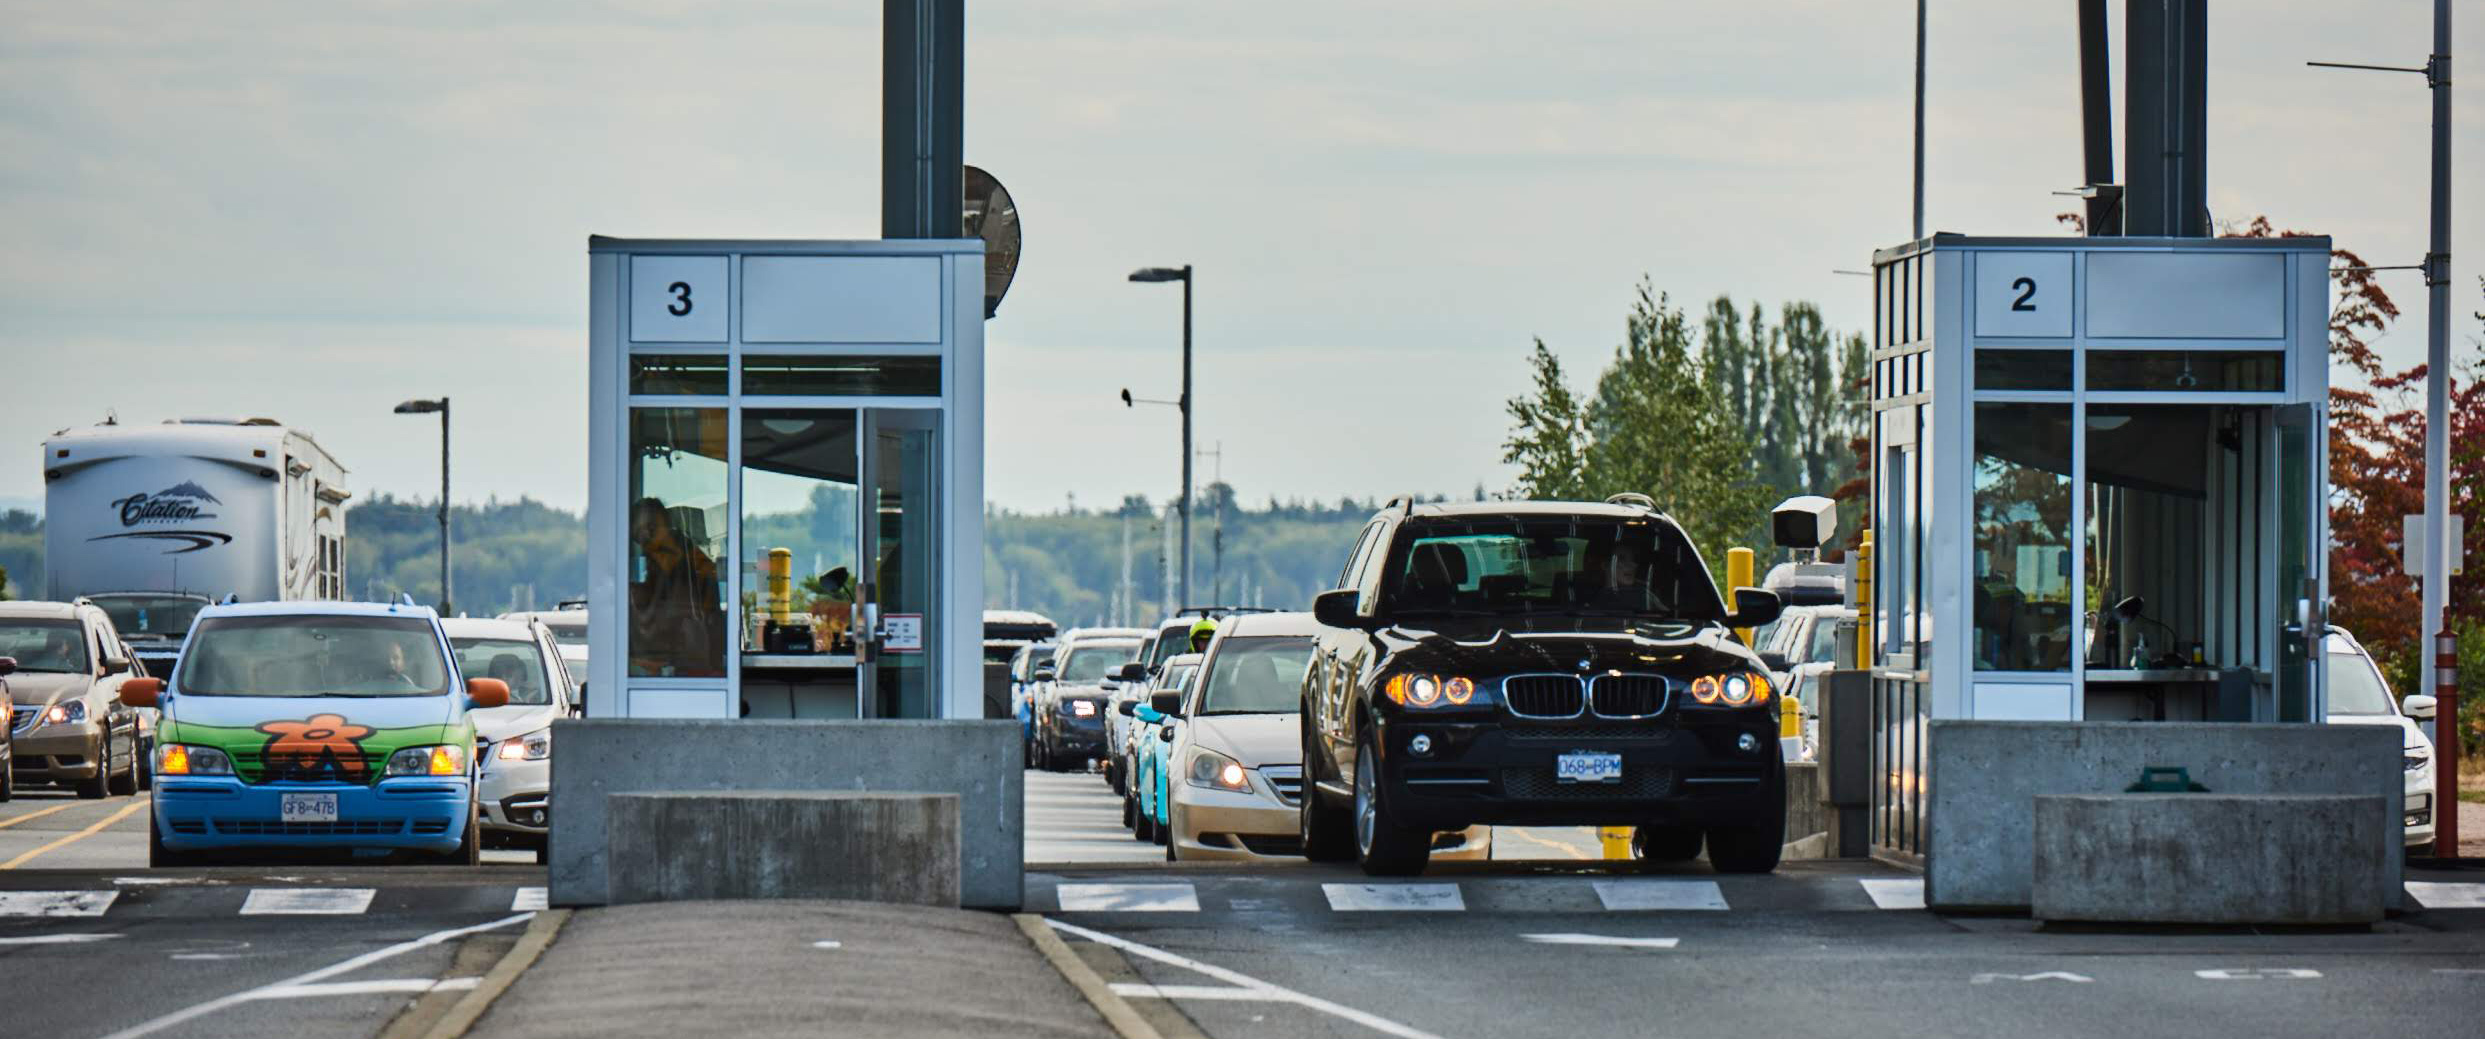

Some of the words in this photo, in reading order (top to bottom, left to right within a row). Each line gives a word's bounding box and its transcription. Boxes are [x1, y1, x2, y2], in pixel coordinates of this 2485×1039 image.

[667, 281, 693, 317] 3
[2011, 276, 2037, 312] 2
[111, 493, 217, 527] Citation
